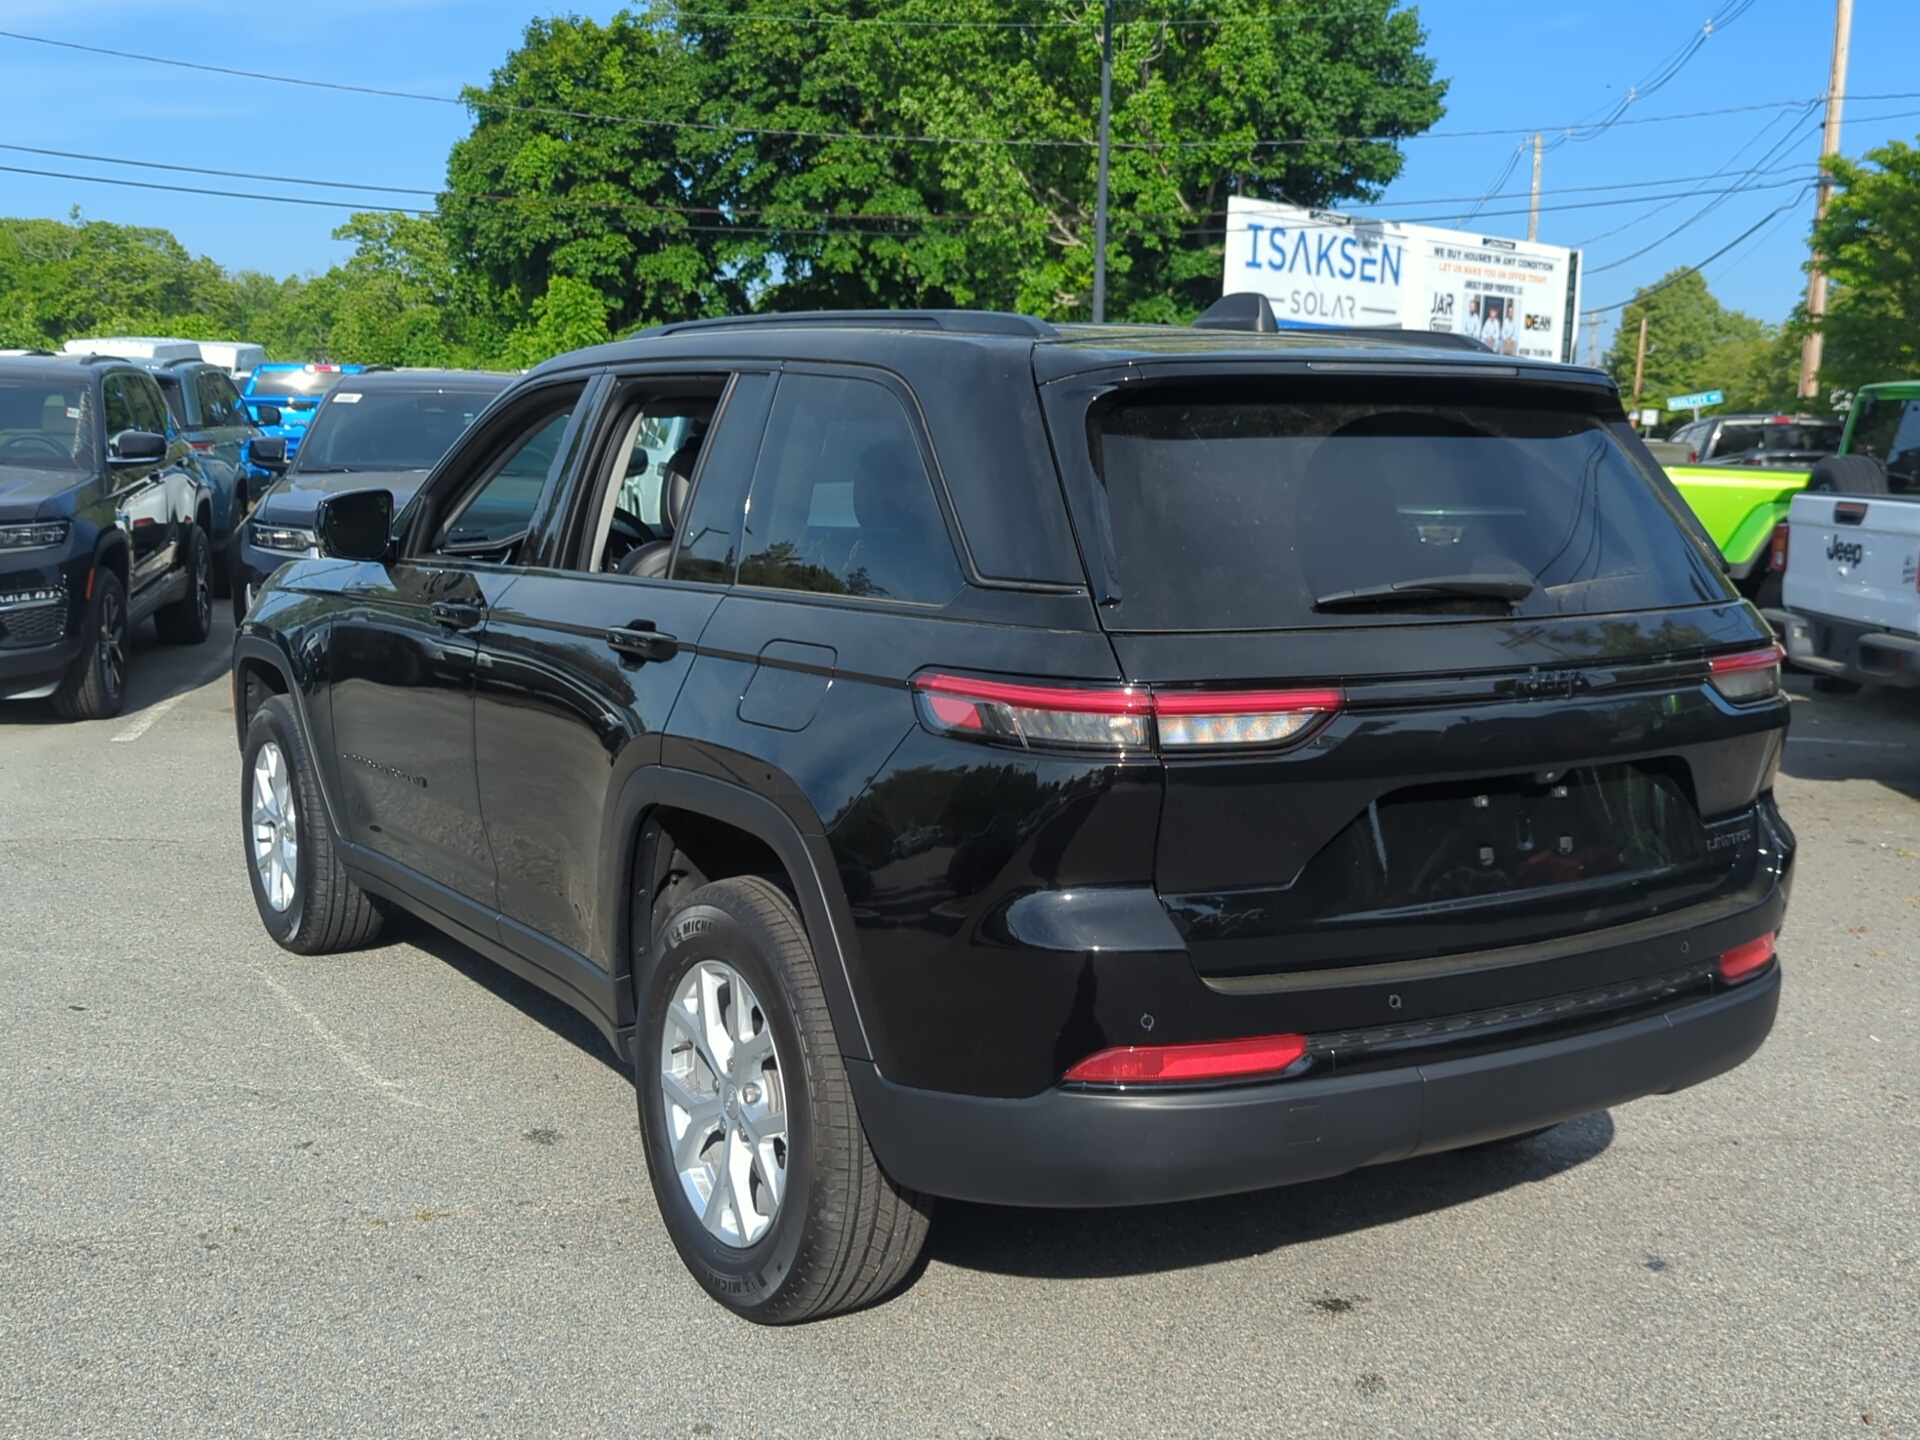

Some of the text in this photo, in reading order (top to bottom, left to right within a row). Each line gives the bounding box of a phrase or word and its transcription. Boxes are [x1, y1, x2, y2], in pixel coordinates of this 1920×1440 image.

[1245, 222, 1402, 286] ISAKSEN
[1433, 247, 1554, 271] WE BUY HOUSES IN ANY CONDITION
[1289, 289, 1357, 319] SOLAR
[1430, 290, 1454, 315] JAR
[1524, 313, 1551, 331] DEAN
[1827, 534, 1863, 569] Jeep
